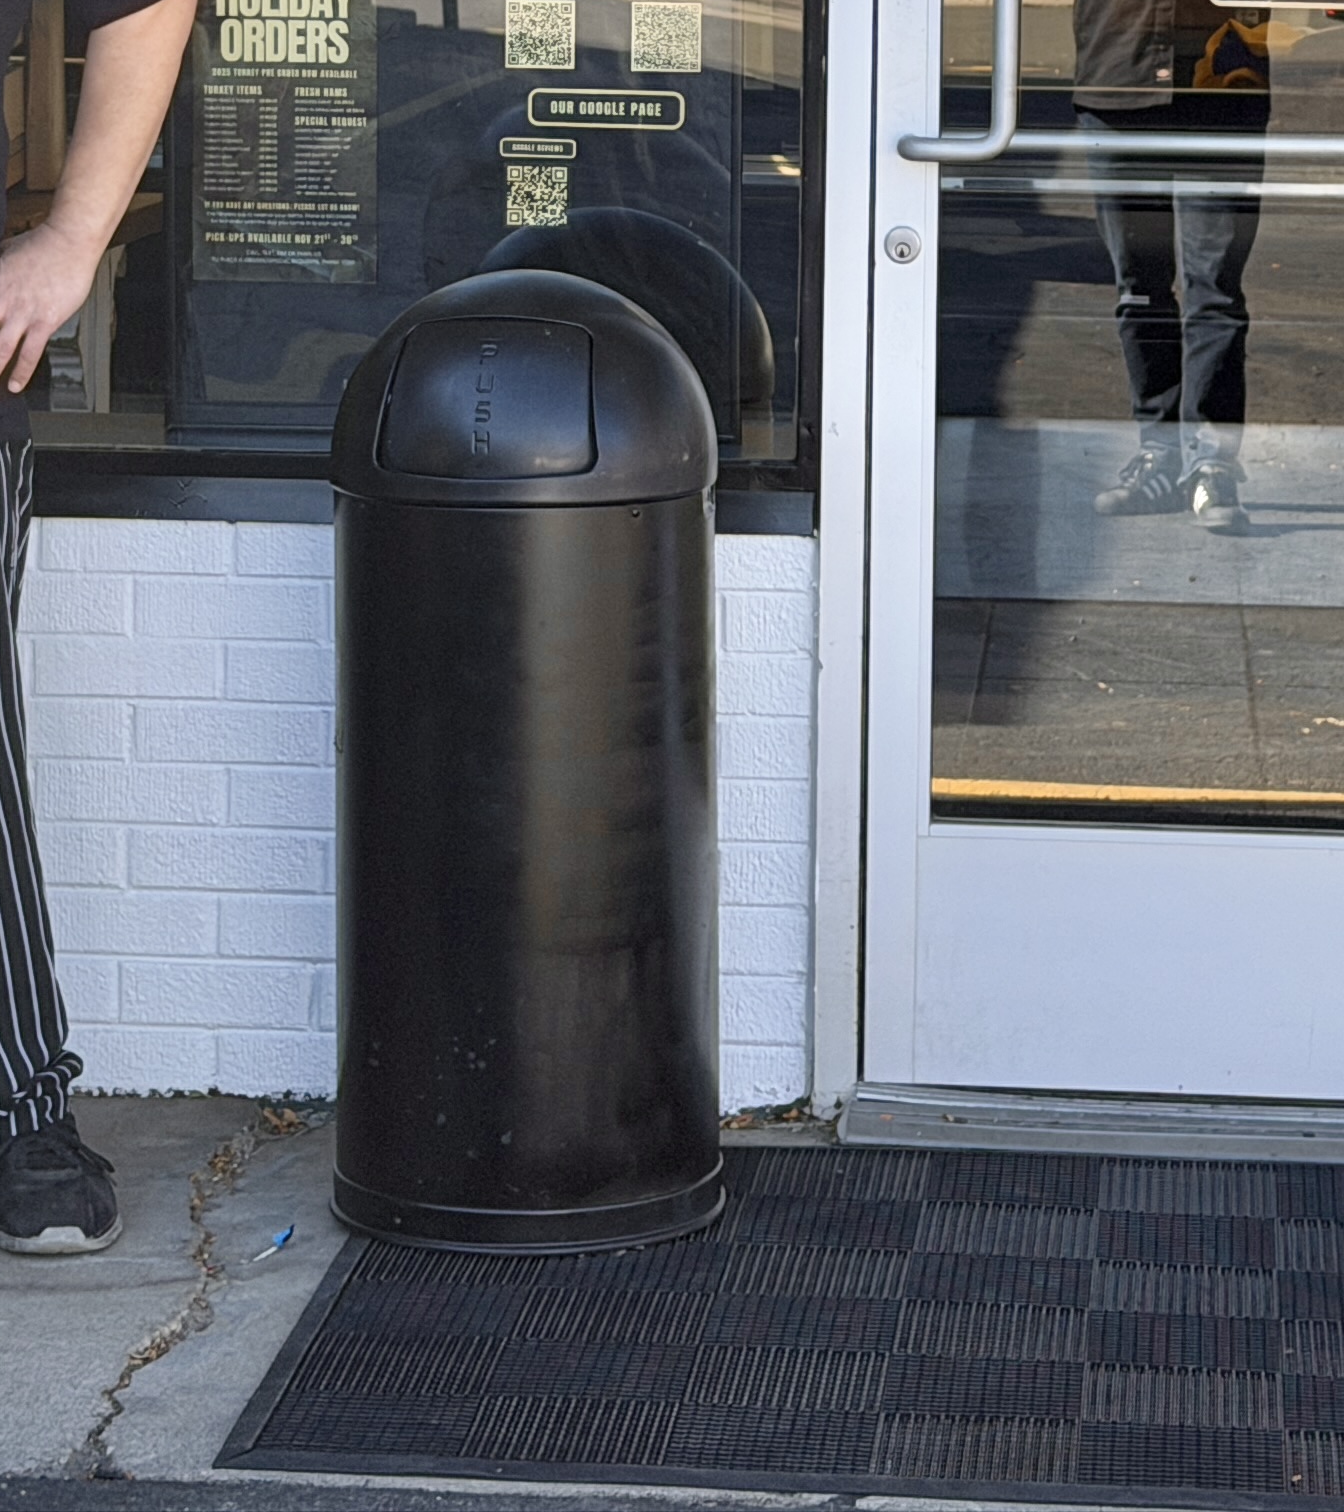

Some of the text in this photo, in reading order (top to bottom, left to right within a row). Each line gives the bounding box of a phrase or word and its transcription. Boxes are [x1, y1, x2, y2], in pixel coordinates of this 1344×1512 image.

[220, 18, 350, 64] ORDERS
[294, 116, 329, 126] SPECIAL
[550, 100, 662, 117] OUR GOOGLE PAGE
[470, 343, 499, 455] PUSH
